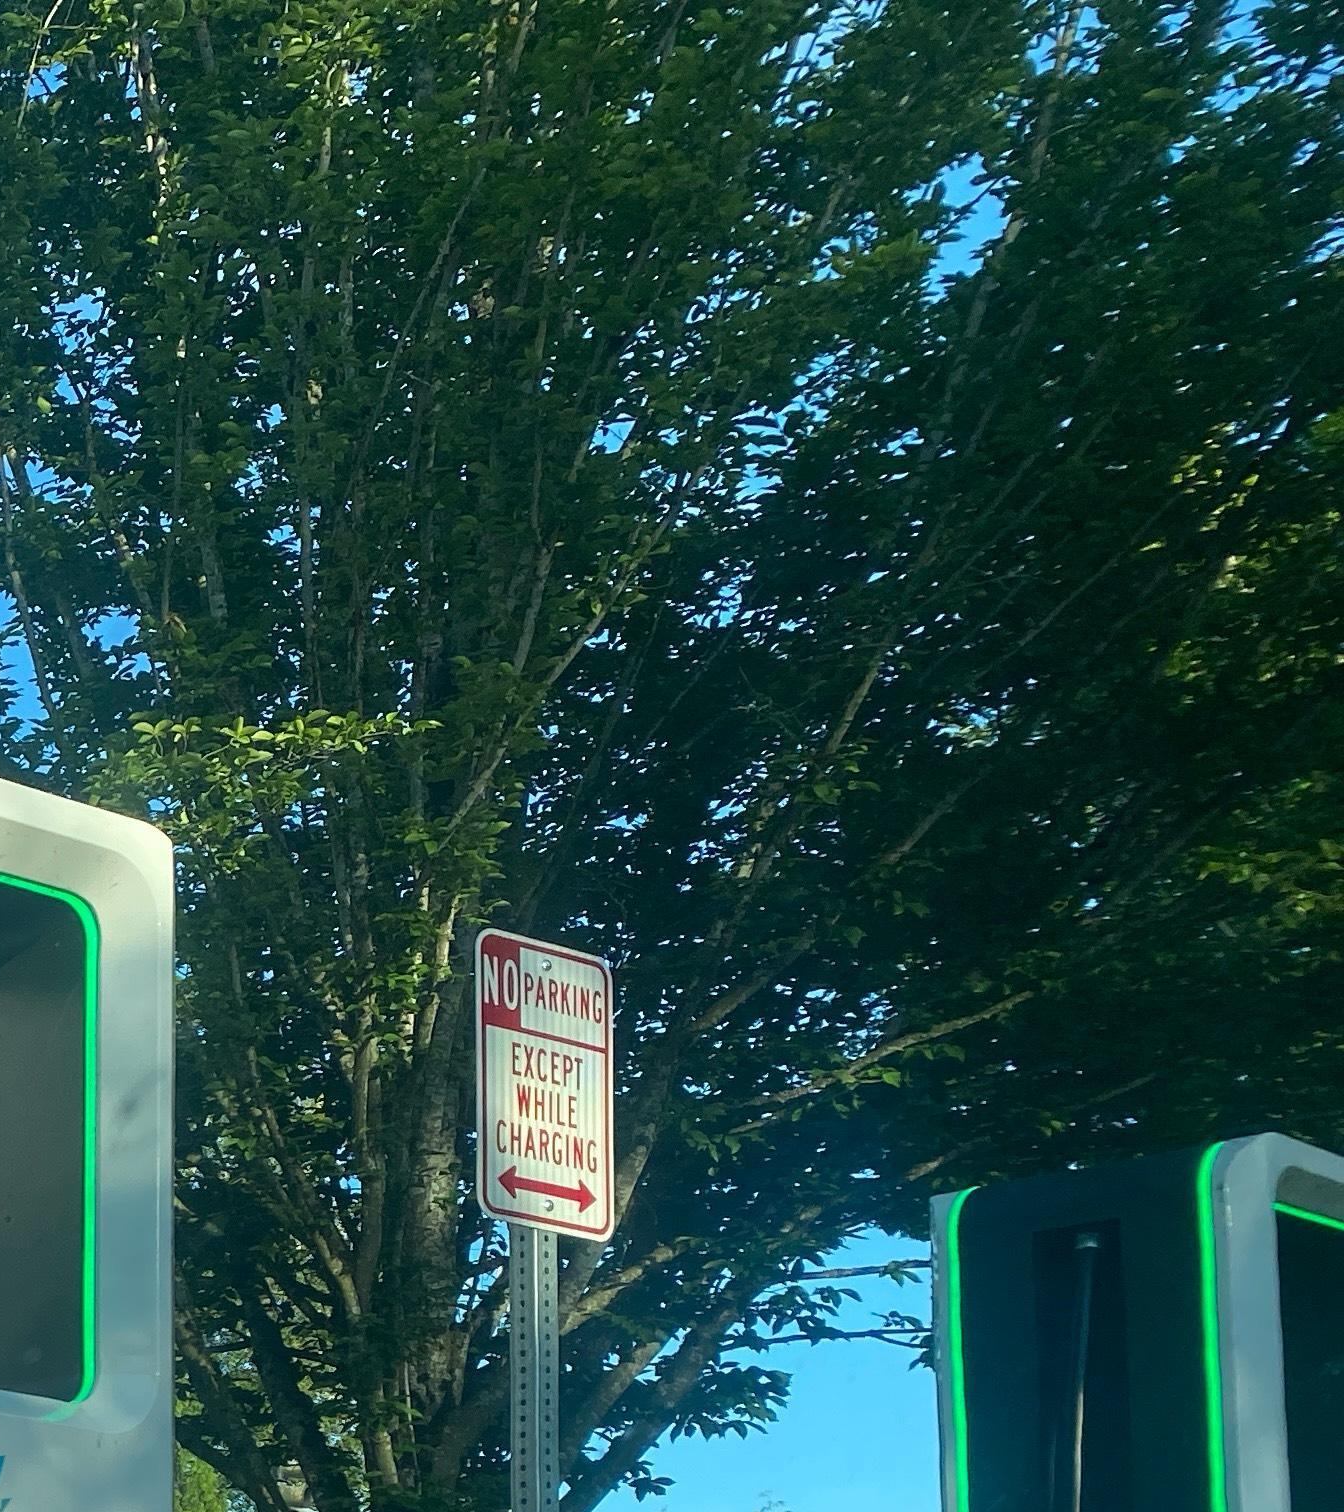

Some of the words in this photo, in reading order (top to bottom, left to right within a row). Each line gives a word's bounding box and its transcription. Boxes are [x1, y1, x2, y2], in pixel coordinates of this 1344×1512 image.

[483, 953, 519, 1011] NO
[524, 972, 603, 1025] PARKING
[511, 1041, 583, 1090] EXCEPT
[516, 1083, 578, 1129] WHILE
[496, 1119, 597, 1174] CHARGING
